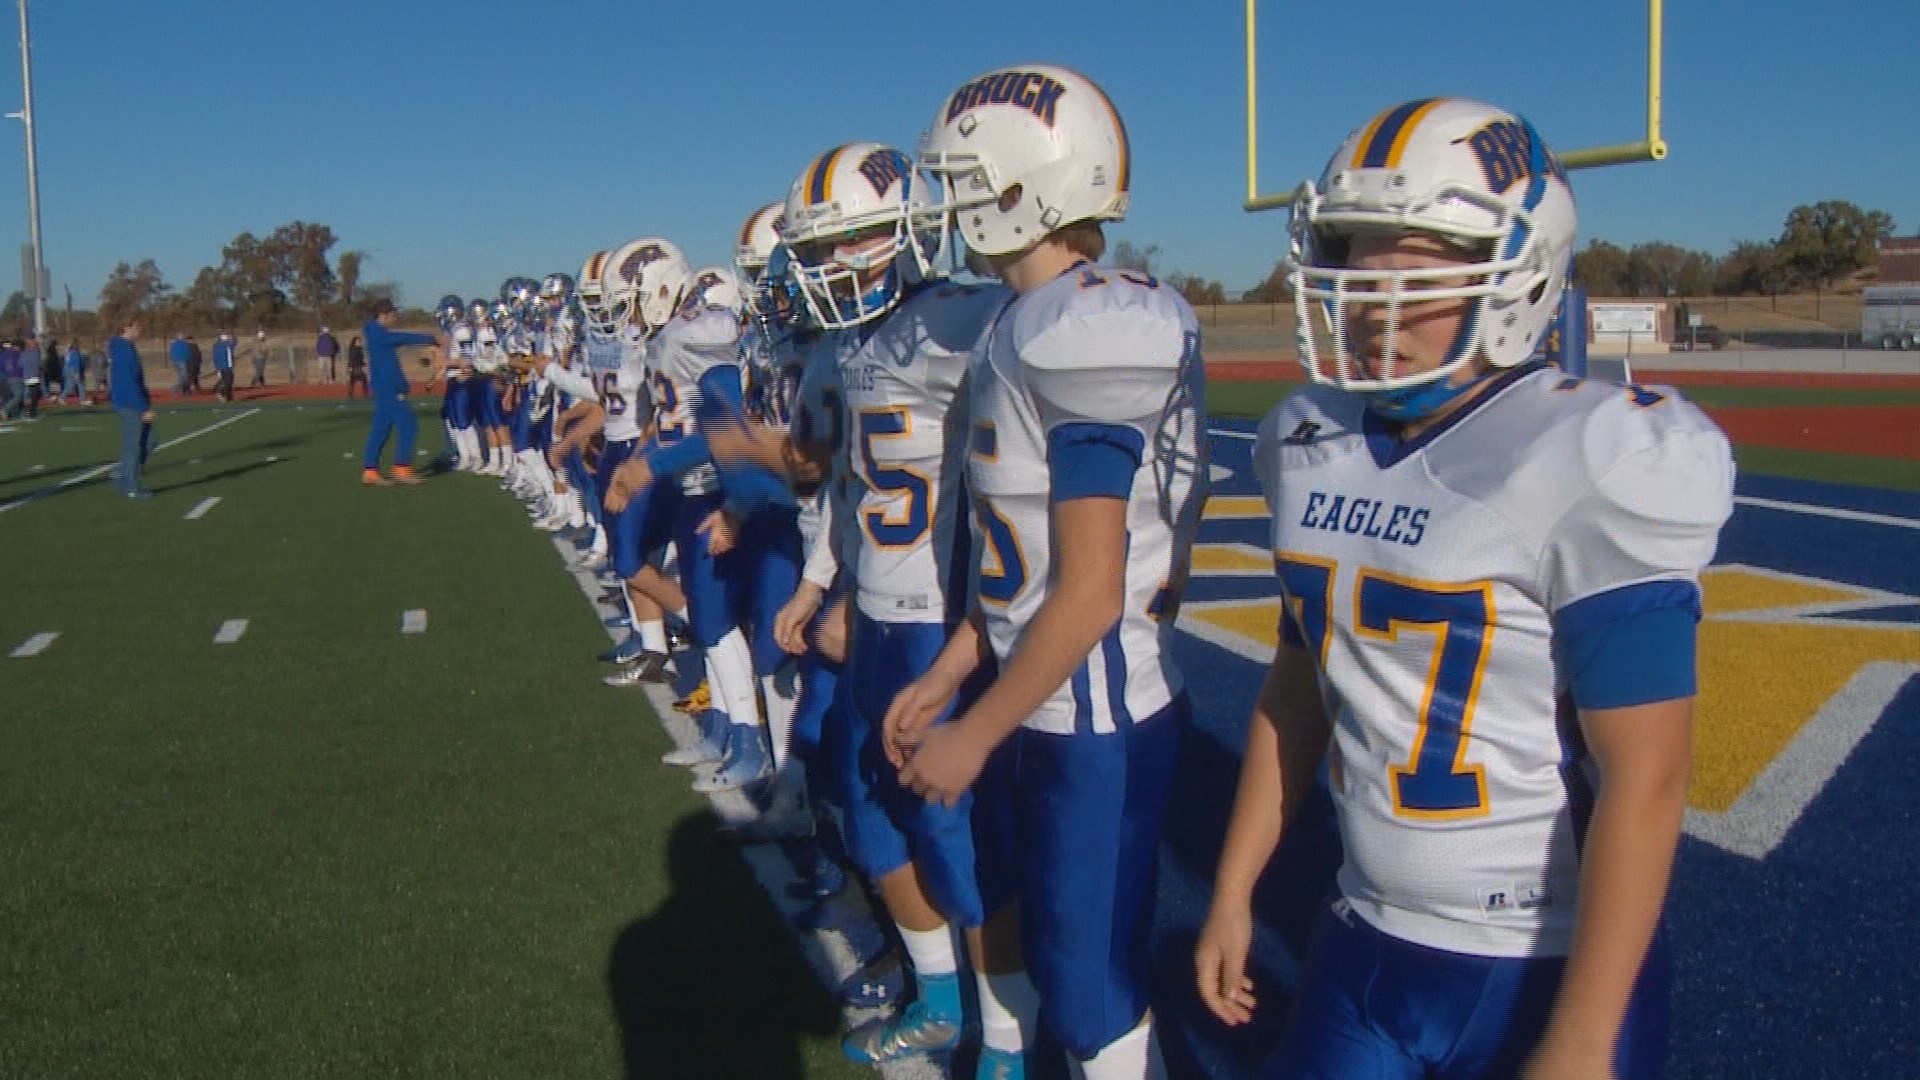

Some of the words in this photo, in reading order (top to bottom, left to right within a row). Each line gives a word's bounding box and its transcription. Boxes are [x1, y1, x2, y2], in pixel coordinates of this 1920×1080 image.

[944, 71, 1066, 130] BROCK
[1300, 492, 1430, 546] EAGLES
[1275, 550, 1497, 819] 77
